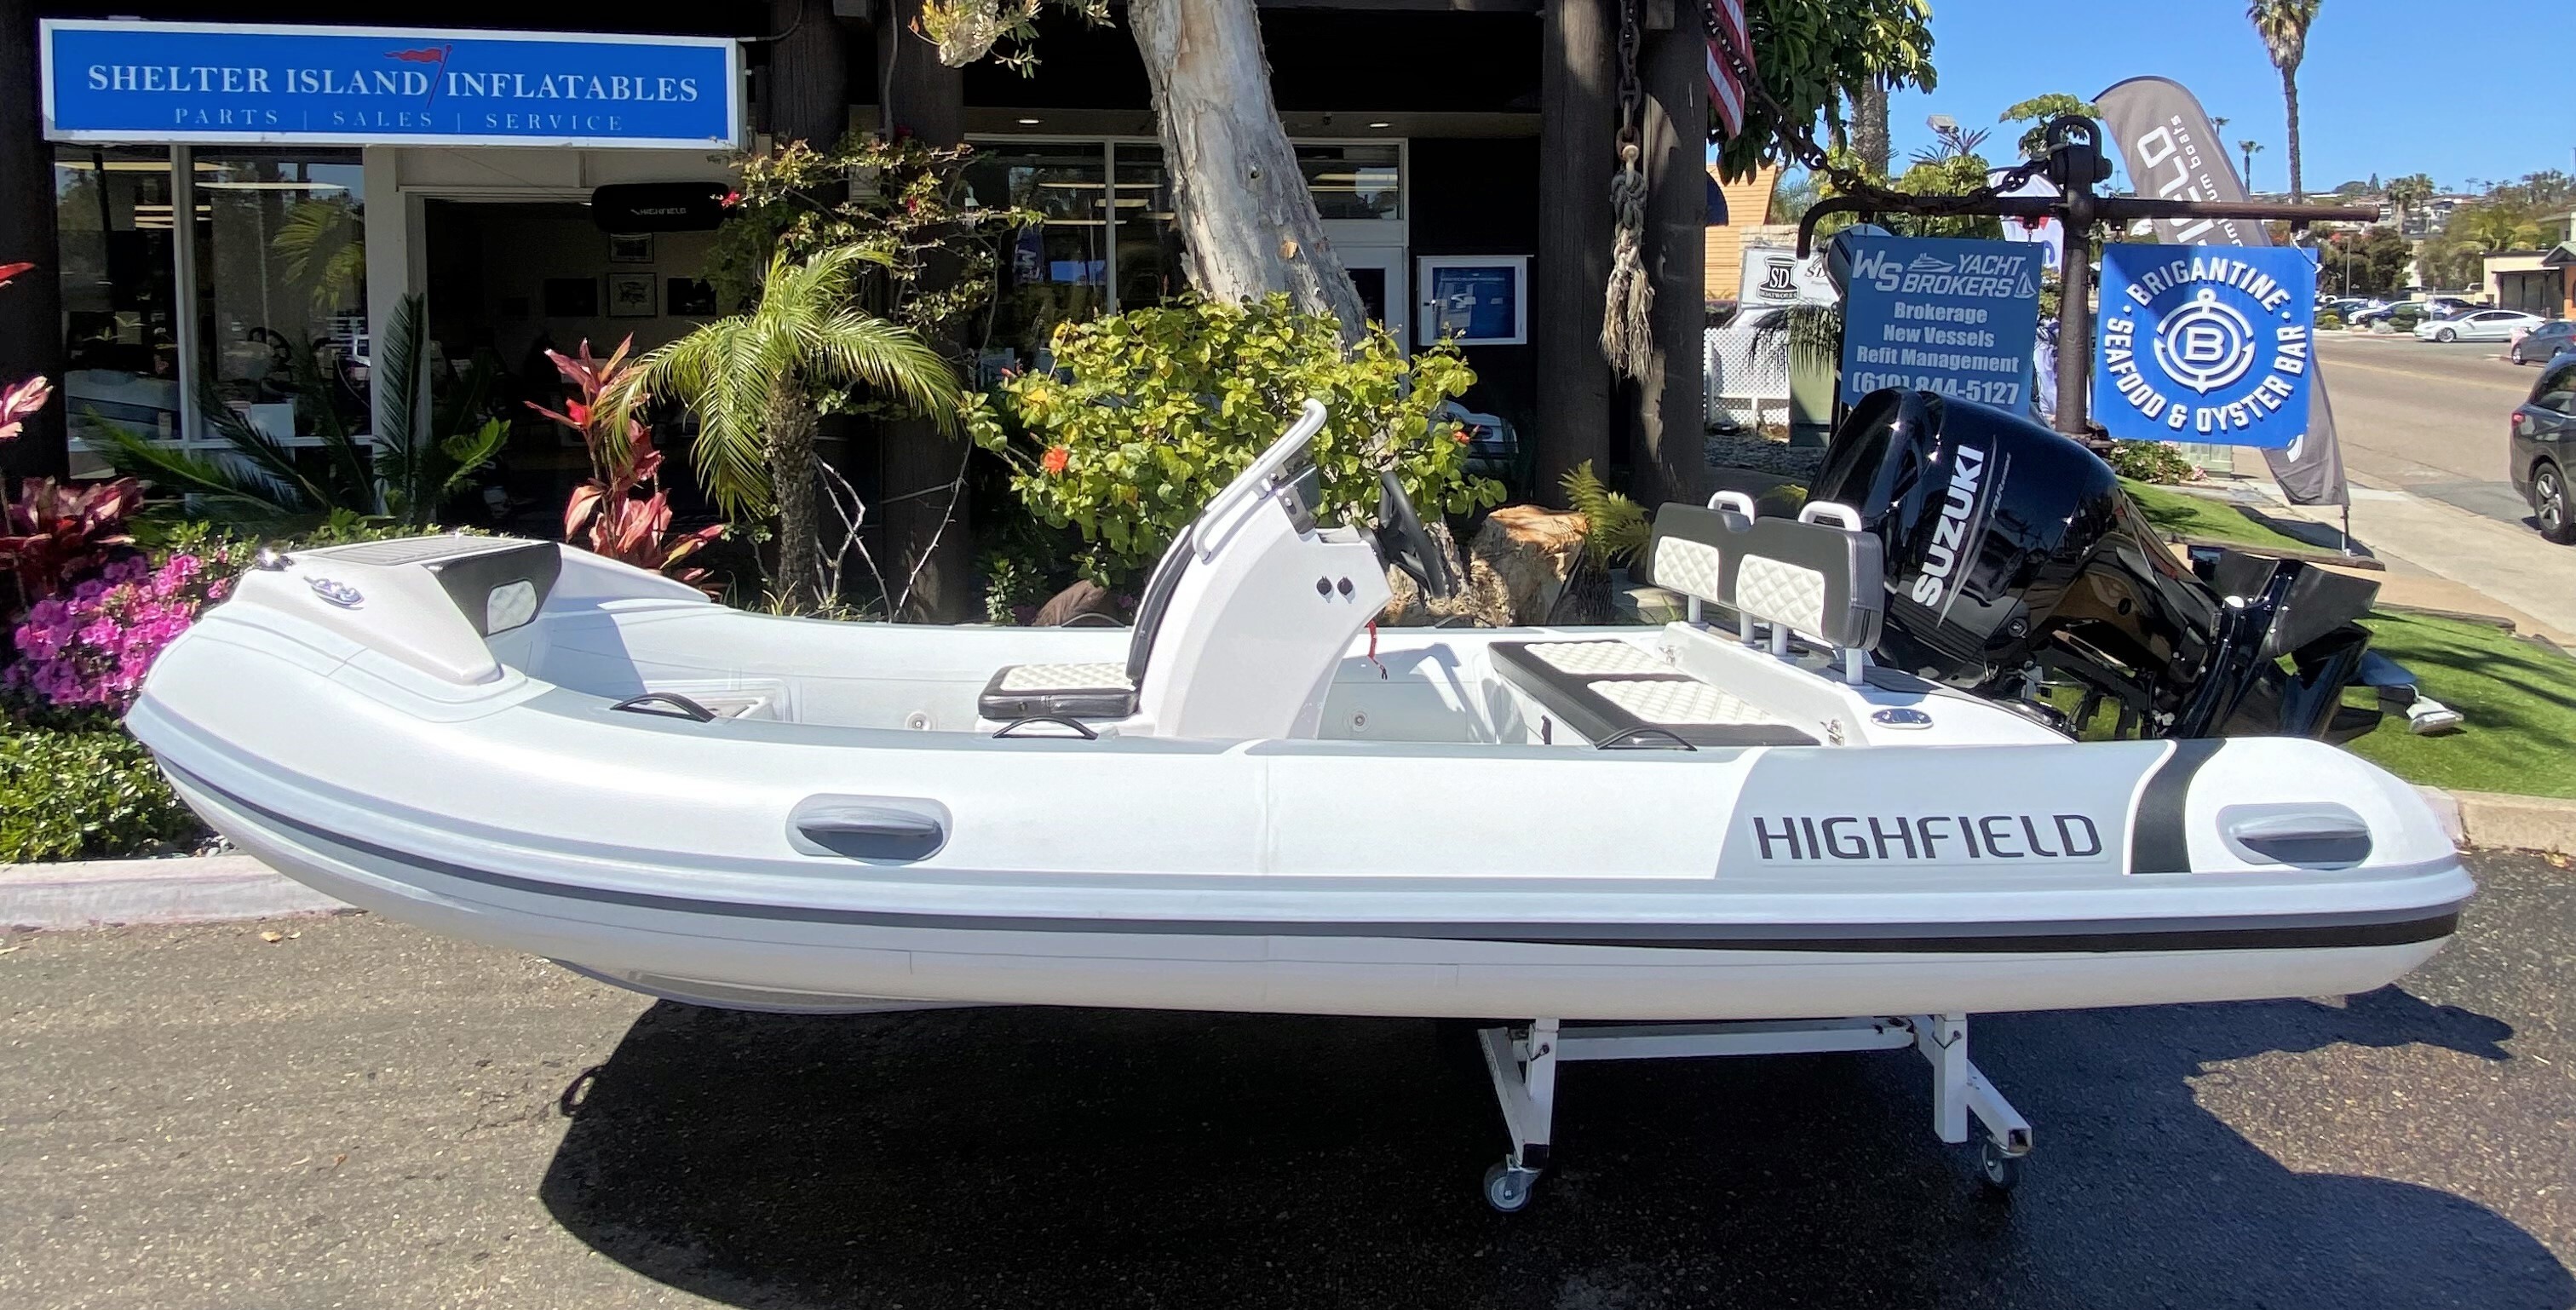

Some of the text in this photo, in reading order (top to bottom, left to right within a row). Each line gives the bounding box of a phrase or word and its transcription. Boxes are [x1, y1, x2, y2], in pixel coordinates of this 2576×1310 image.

[88, 64, 699, 103] SHELTER ISLAND INFLATABLES
[175, 107, 623, 131] PARTS SALES SERVICE
[2170, 114, 2202, 169] boats
[1769, 267, 1790, 289] SD
[1851, 249, 1904, 293] WS
[1957, 253, 2027, 277] YACHT
[1900, 273, 2015, 298] BROKERS
[2125, 256, 2292, 313] BRIGANTINE
[1894, 302, 1989, 325] Brokerage
[1883, 324, 1995, 348] New Vessels
[2182, 326, 2226, 362] B
[1856, 345, 2020, 373] Refit Management
[2104, 317, 2308, 434] SEAFOOD & OYSTER BAR
[1914, 375, 2020, 405] 844-5127
[1911, 443, 1985, 608] SUZUKI
[1752, 814, 2103, 860] HIGHFIELD
